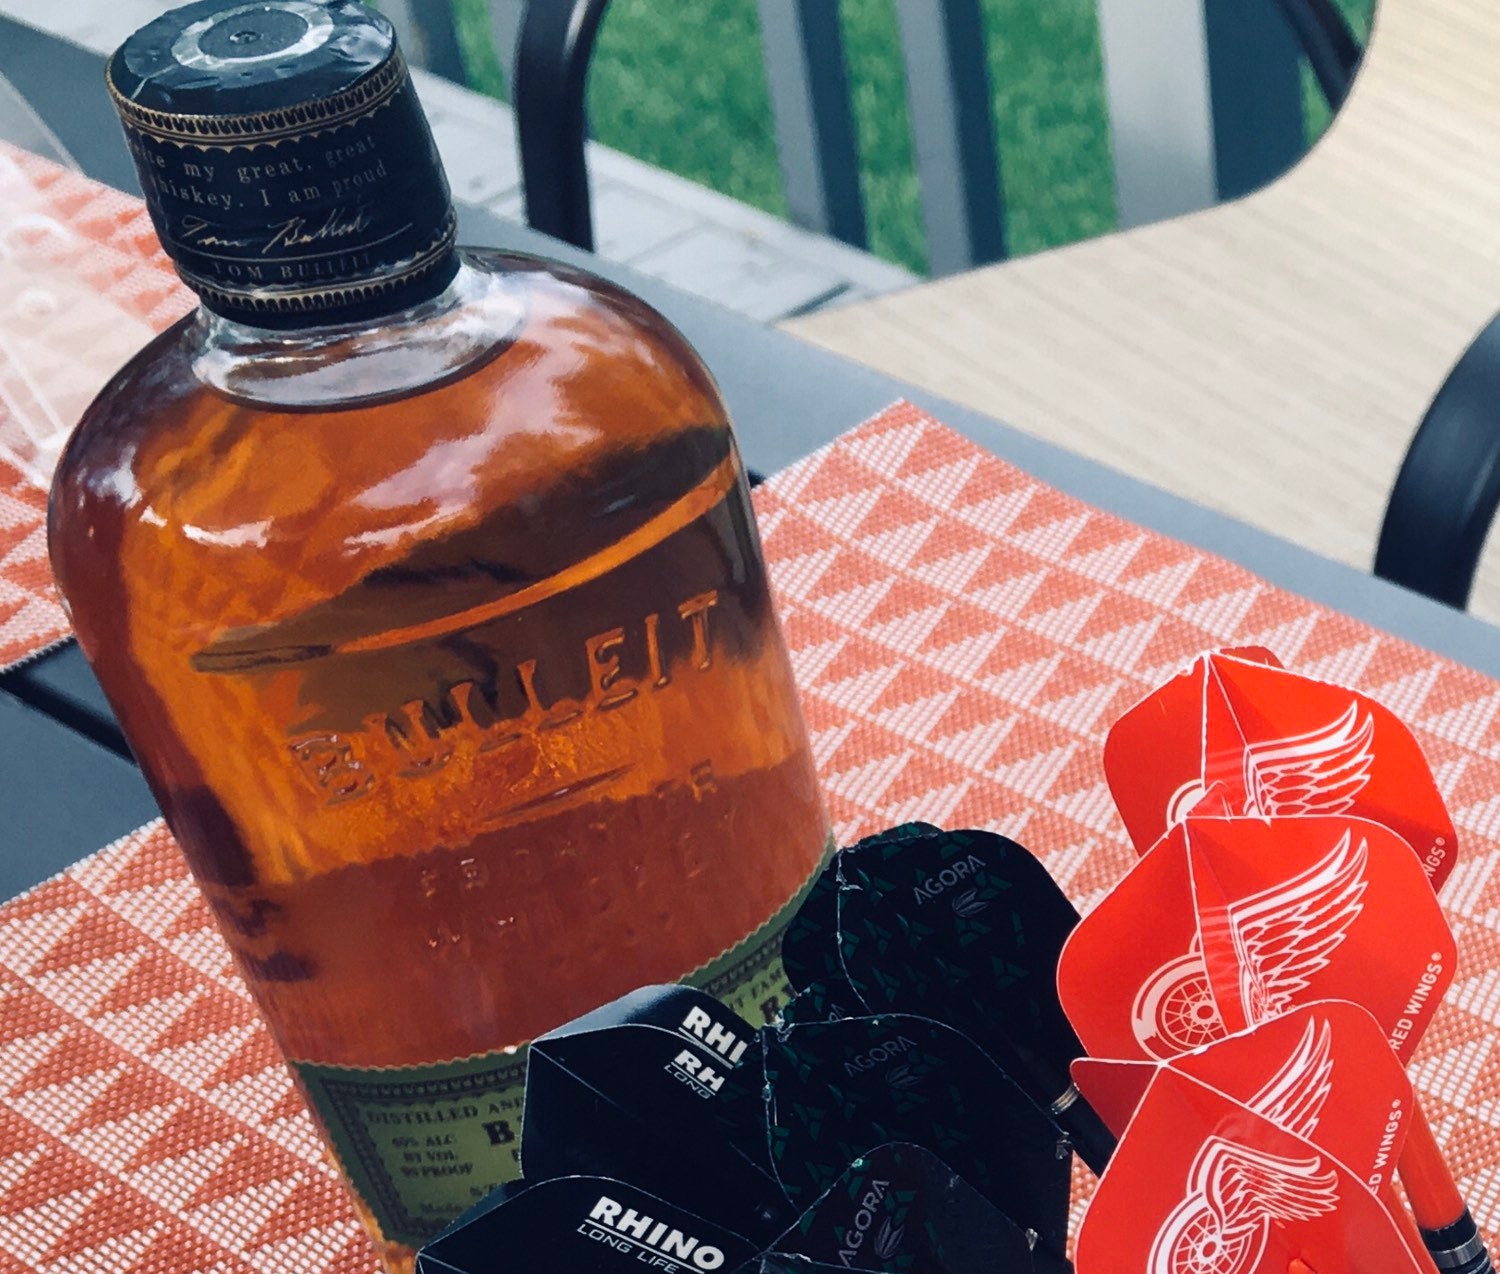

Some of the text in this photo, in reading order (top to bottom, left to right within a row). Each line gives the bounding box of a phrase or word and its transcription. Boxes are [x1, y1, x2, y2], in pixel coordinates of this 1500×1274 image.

[184, 161, 215, 183] my
[325, 136, 377, 168] great
[260, 188, 272, 207] I
[288, 185, 321, 203] am
[332, 159, 387, 198] proud
[913, 854, 986, 905] AGORA
[682, 1005, 749, 1064] RHI
[843, 1035, 918, 1077] AGORA
[1388, 1017, 1413, 1050] RED
[664, 1064, 712, 1100] LONG
[577, 1223, 680, 1274] LONG LIFE
[588, 1195, 725, 1270] RHINO
[838, 1179, 890, 1269] AGORA
